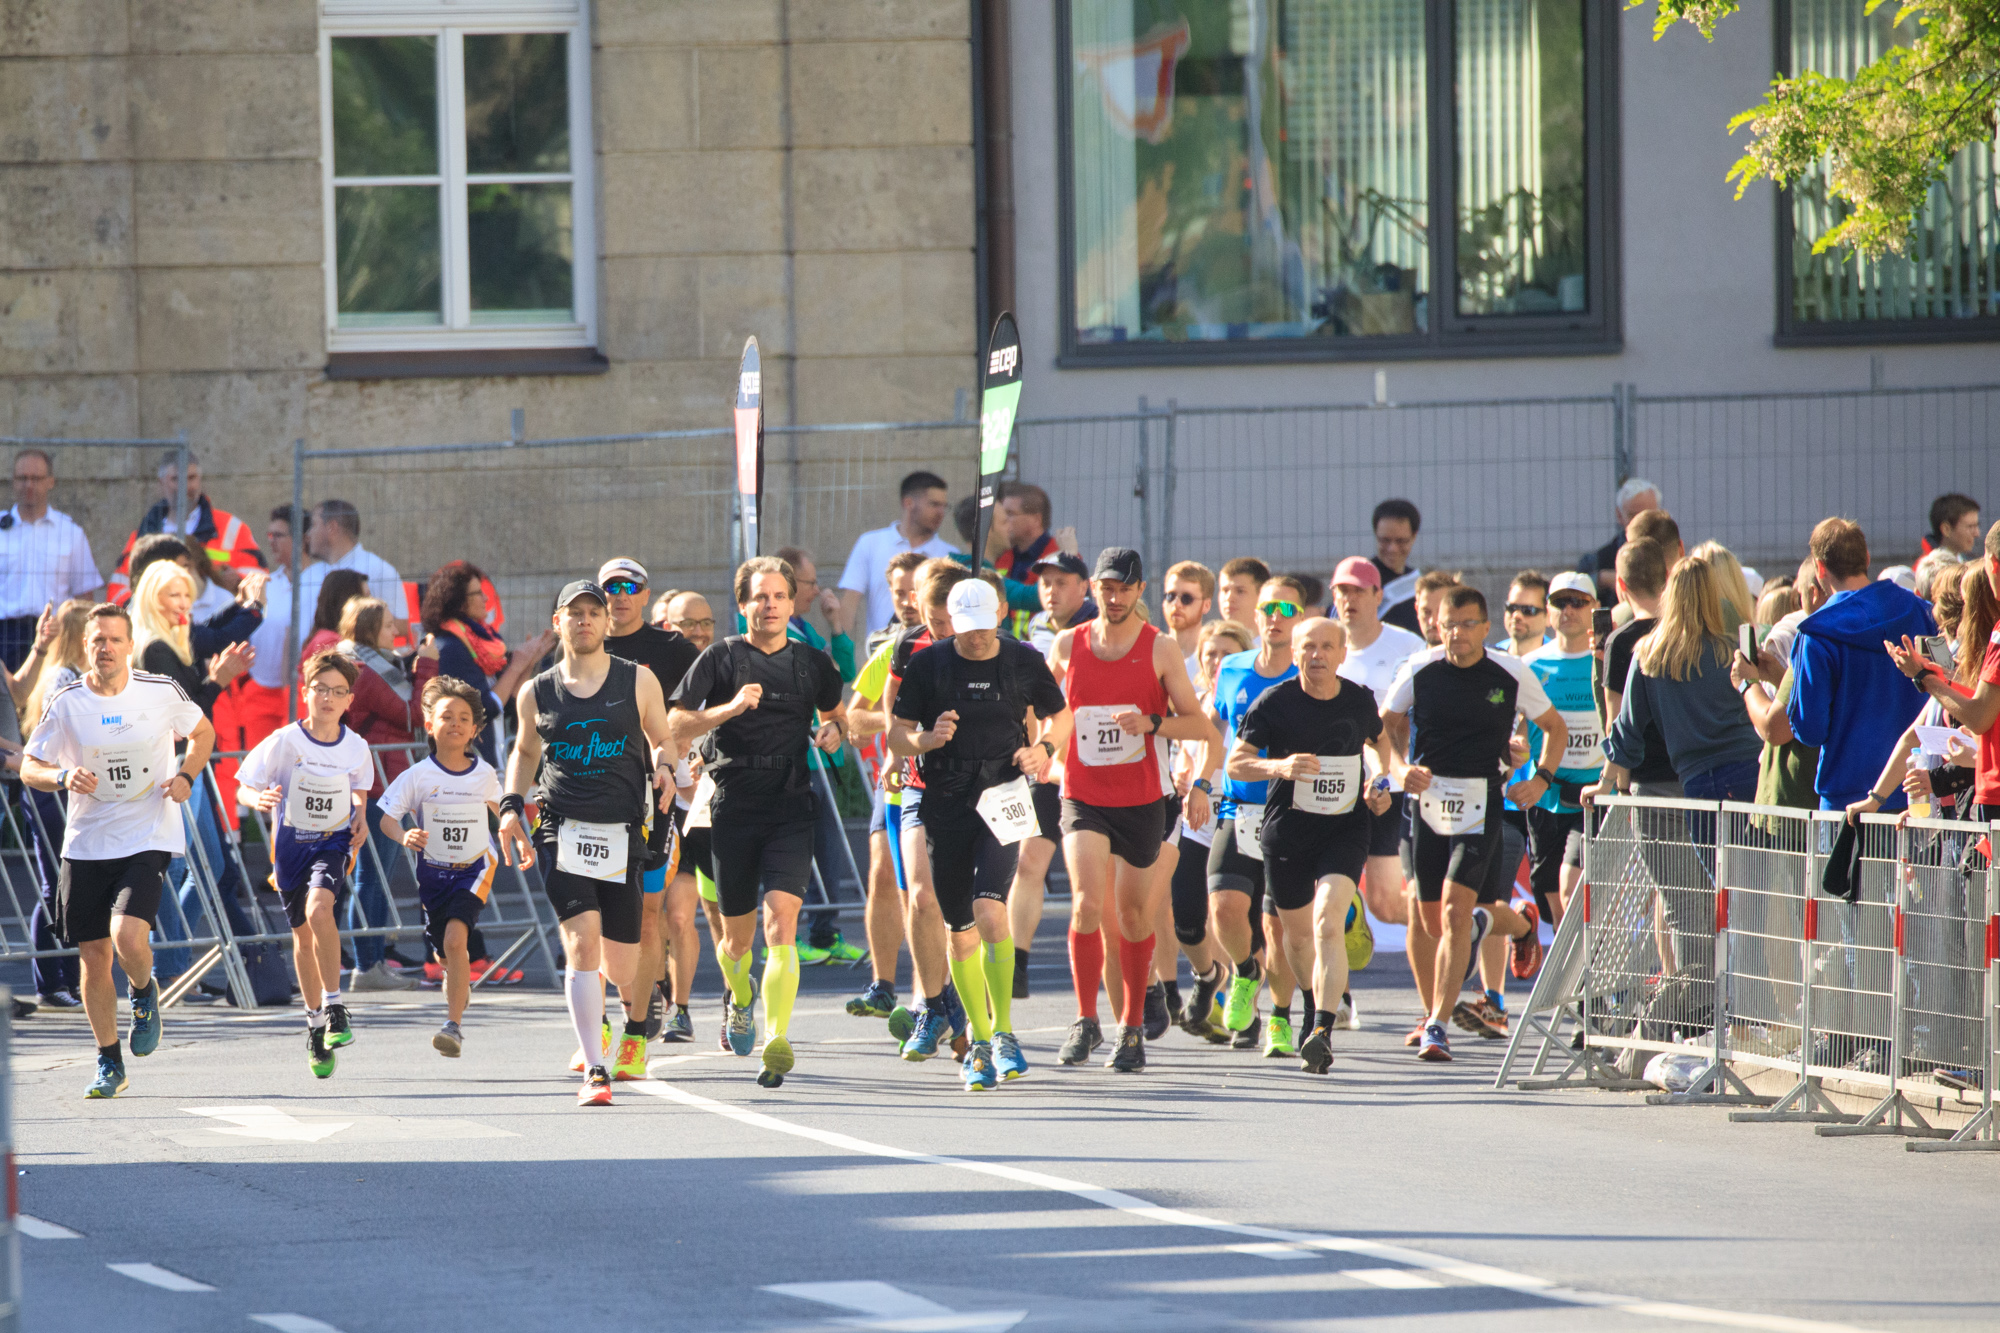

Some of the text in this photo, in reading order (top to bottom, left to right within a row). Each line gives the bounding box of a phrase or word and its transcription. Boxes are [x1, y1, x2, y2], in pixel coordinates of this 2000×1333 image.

[999, 345, 1018, 377] cep
[975, 682, 991, 690] cep
[1565, 692, 1593, 701] Würz
[1098, 729, 1120, 744] 217
[1567, 733, 1599, 748] 0267
[550, 731, 628, 766] Run fleet!
[107, 765, 132, 781] 115
[573, 768, 606, 776] HAMBURG
[1313, 779, 1345, 794] 1655
[305, 796, 333, 812] 834
[1002, 802, 1026, 820] 380
[1441, 800, 1465, 814] 102
[442, 827, 469, 842] 837
[576, 842, 609, 859] 1675
